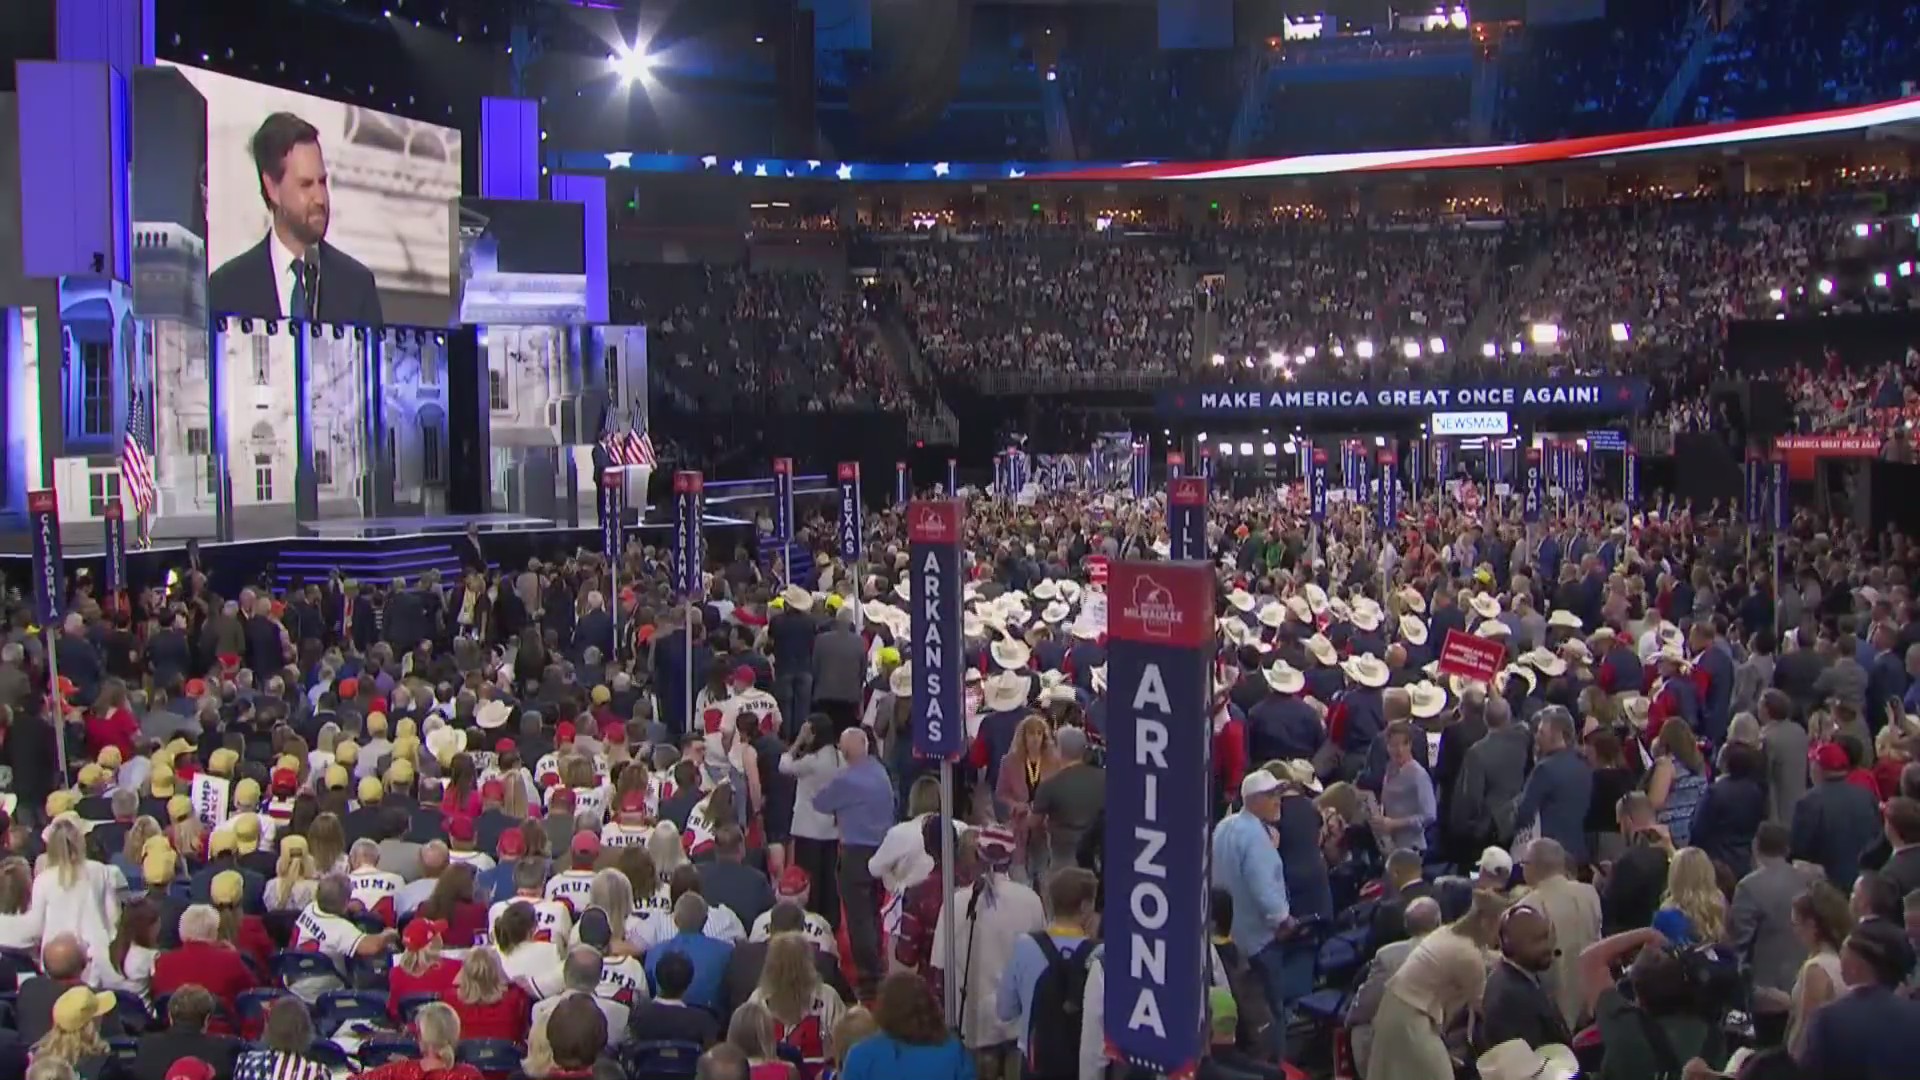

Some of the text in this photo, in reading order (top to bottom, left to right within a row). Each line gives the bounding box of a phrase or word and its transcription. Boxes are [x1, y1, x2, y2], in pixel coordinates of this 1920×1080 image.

[1201, 386, 1600, 408] MAKE AMERICA GREAT ONCE AGAIN!
[1436, 417, 1504, 429] NEWSMAX
[1526, 467, 1538, 512] GUAM
[843, 484, 855, 555] TEXAS
[678, 493, 687, 590] ALABAMA
[40, 512, 59, 618] CALIFORNIA
[923, 551, 944, 742] ARKANSAS
[200, 780, 211, 823] RUMP
[607, 836, 646, 847] TRUM
[1127, 663, 1172, 1039] ARIZONA
[350, 879, 395, 891] RUMP
[634, 898, 671, 909] UMP
[299, 913, 327, 941] RUMP
[763, 921, 823, 937] TMP
